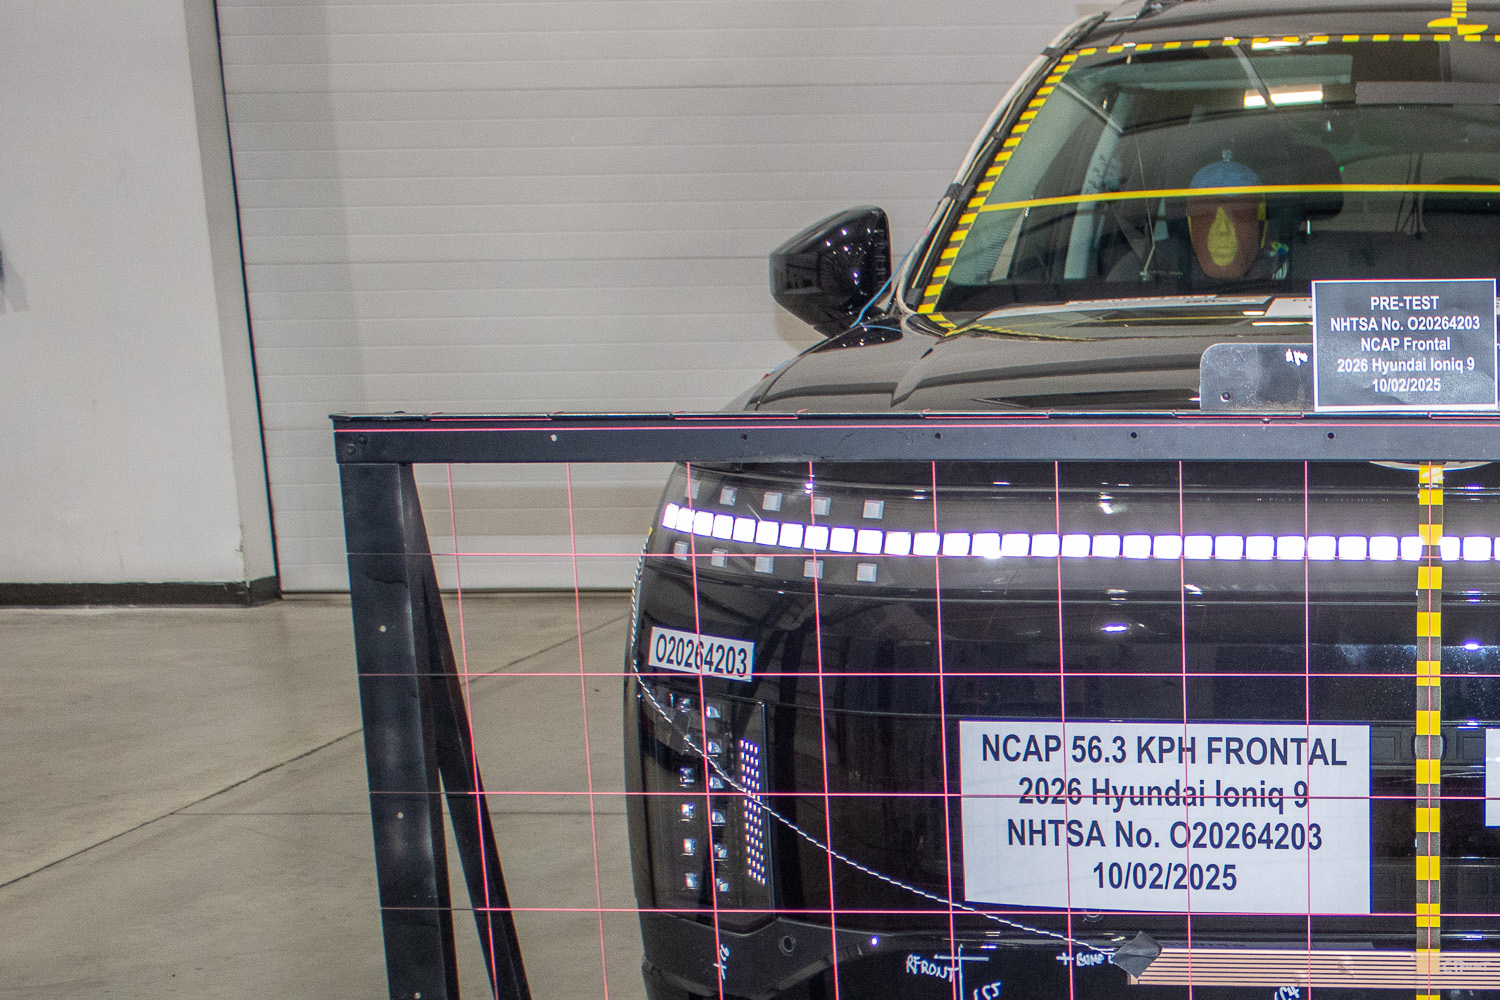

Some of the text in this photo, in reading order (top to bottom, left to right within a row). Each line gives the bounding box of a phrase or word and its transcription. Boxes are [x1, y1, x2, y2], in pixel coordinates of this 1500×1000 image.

[1370, 296, 1440, 310] PRE-TEST
[1330, 316, 1480, 331] NHTSA No. O20264203
[1361, 337, 1451, 351] NCAP Frontal
[1337, 357, 1475, 375] 2026 Hyundai Ioniq 9
[1372, 378, 1441, 392] 10/02/2025
[655, 633, 748, 677] O20264203
[982, 733, 1348, 766] NCAP 56.3 KPH FRONTAL
[1019, 777, 1309, 815] 2026 Hyundai Ioniq 9
[1007, 818, 1323, 850] NHTSA No. O20264203
[1093, 861, 1238, 891] 10/02/2025
